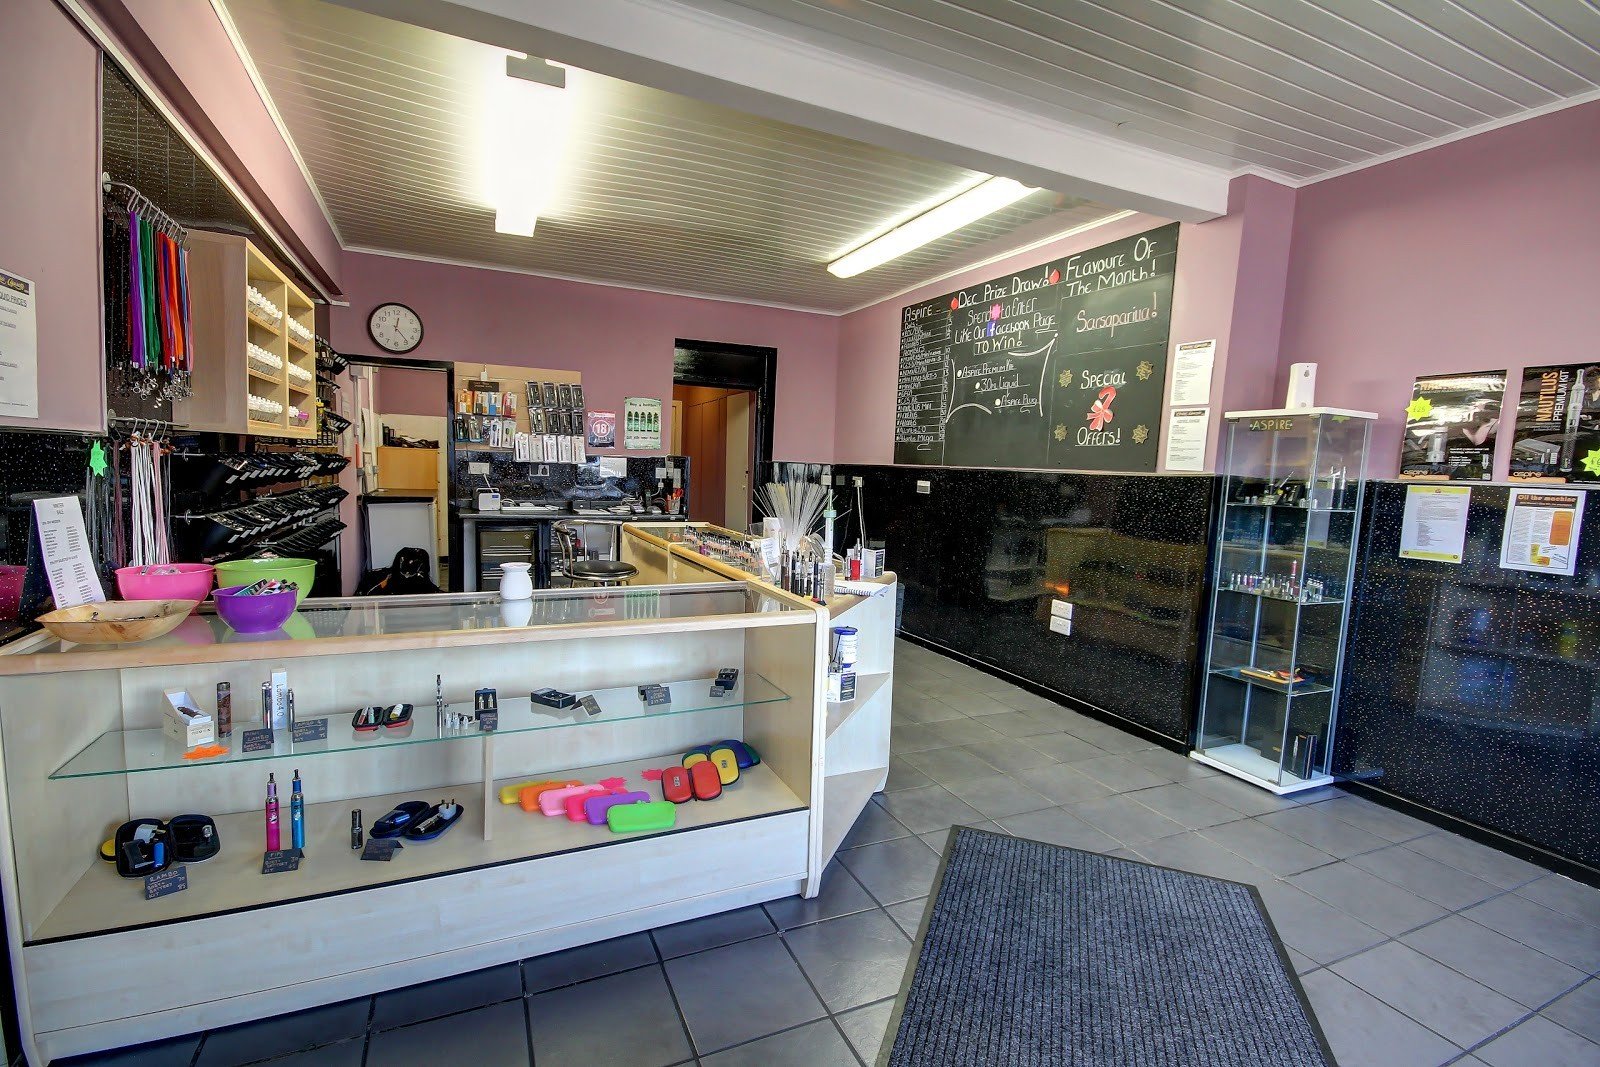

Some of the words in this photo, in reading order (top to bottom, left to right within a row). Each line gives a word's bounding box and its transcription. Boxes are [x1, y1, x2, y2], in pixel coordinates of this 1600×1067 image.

[1133, 237, 1157, 261] Of
[984, 284, 1007, 302] Prize
[1012, 265, 1049, 295] Draw!
[1066, 281, 1091, 297] The
[1098, 259, 1155, 290] Month!
[904, 304, 933, 322] Aspire
[955, 328, 972, 344] Like
[1080, 369, 1127, 389] Special
[1535, 371, 1559, 422] NAUTILUS
[1552, 382, 1567, 422] PREMIUM
[1560, 370, 1569, 382] KIT
[595, 423, 607, 434] 18
[1252, 419, 1292, 431] ASPIRE
[1077, 427, 1121, 446] Offers!
[1403, 469, 1429, 478] aspire
[1513, 471, 1543, 479] aspire
